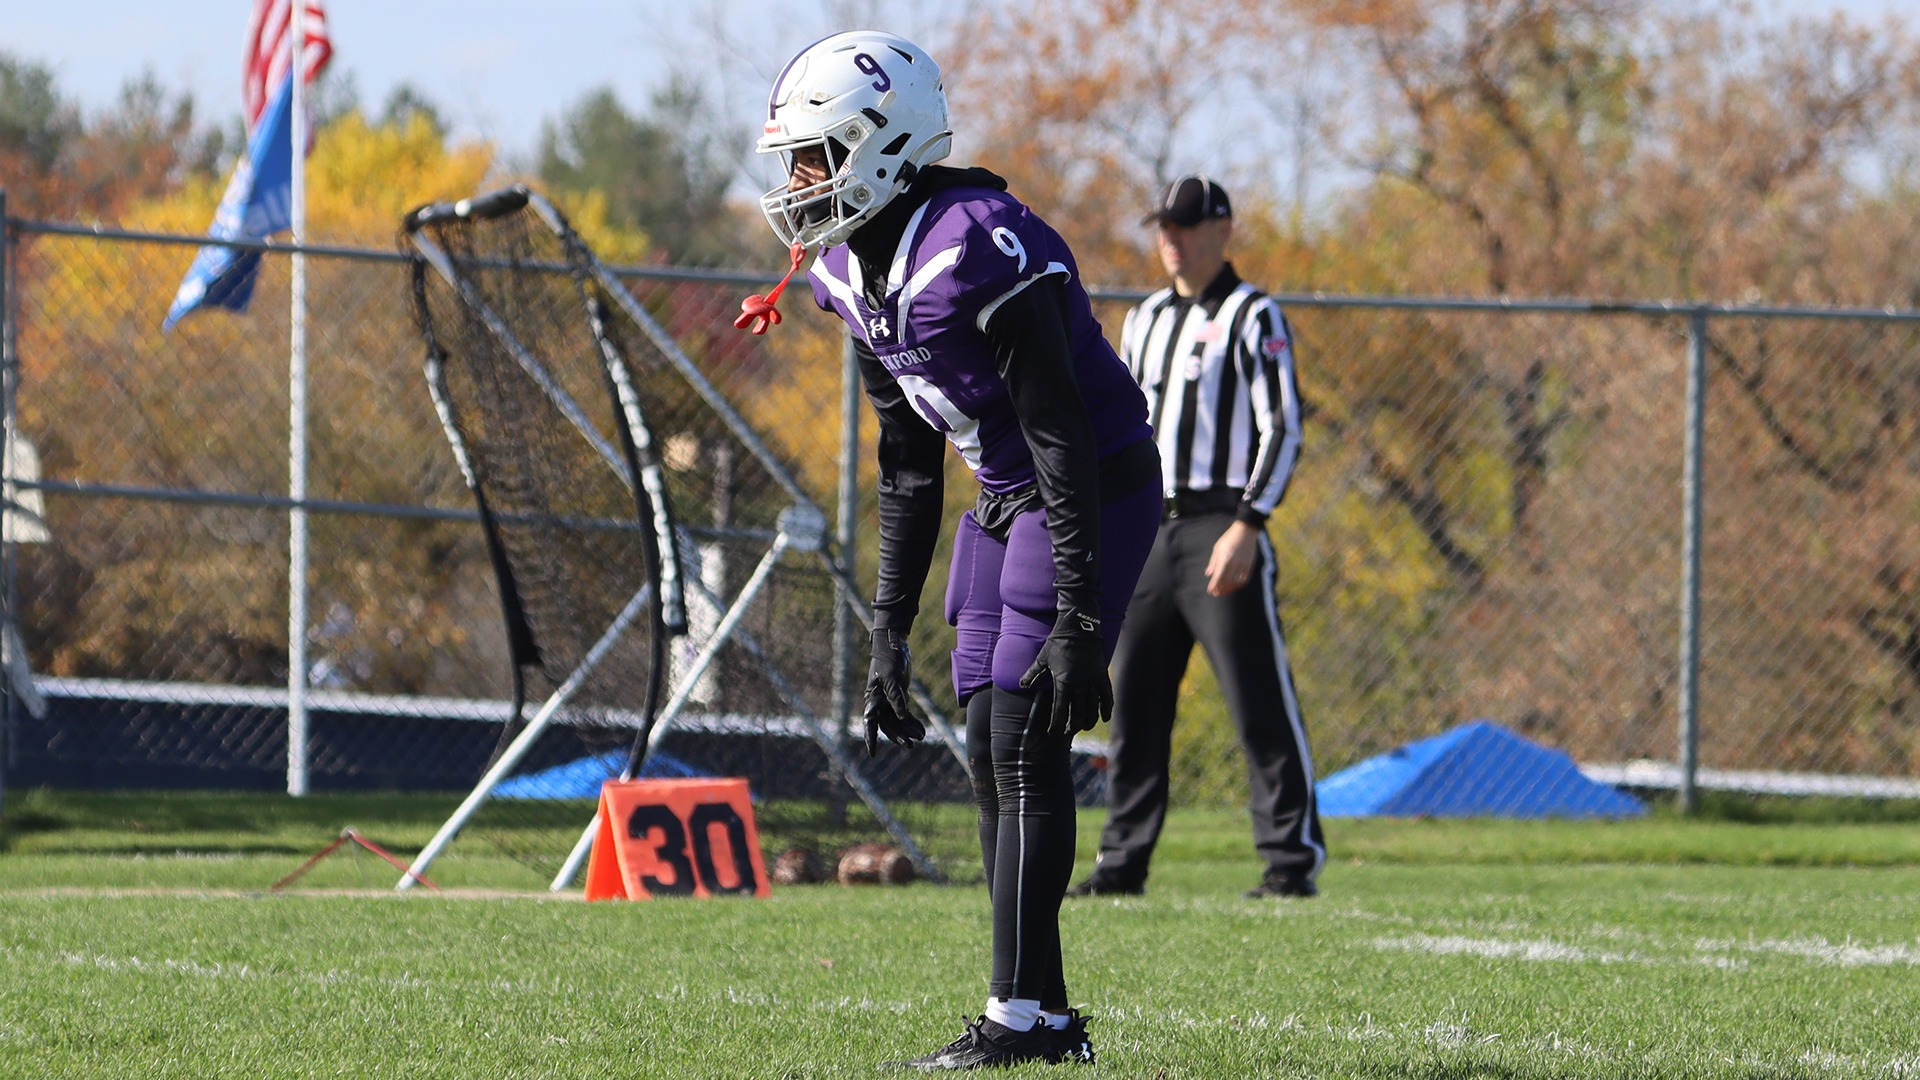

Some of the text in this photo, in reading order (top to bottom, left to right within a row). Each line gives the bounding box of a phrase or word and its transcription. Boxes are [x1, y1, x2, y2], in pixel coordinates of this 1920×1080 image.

[854, 52, 891, 93] 9
[991, 226, 1028, 274] 9
[628, 803, 757, 896] 30
